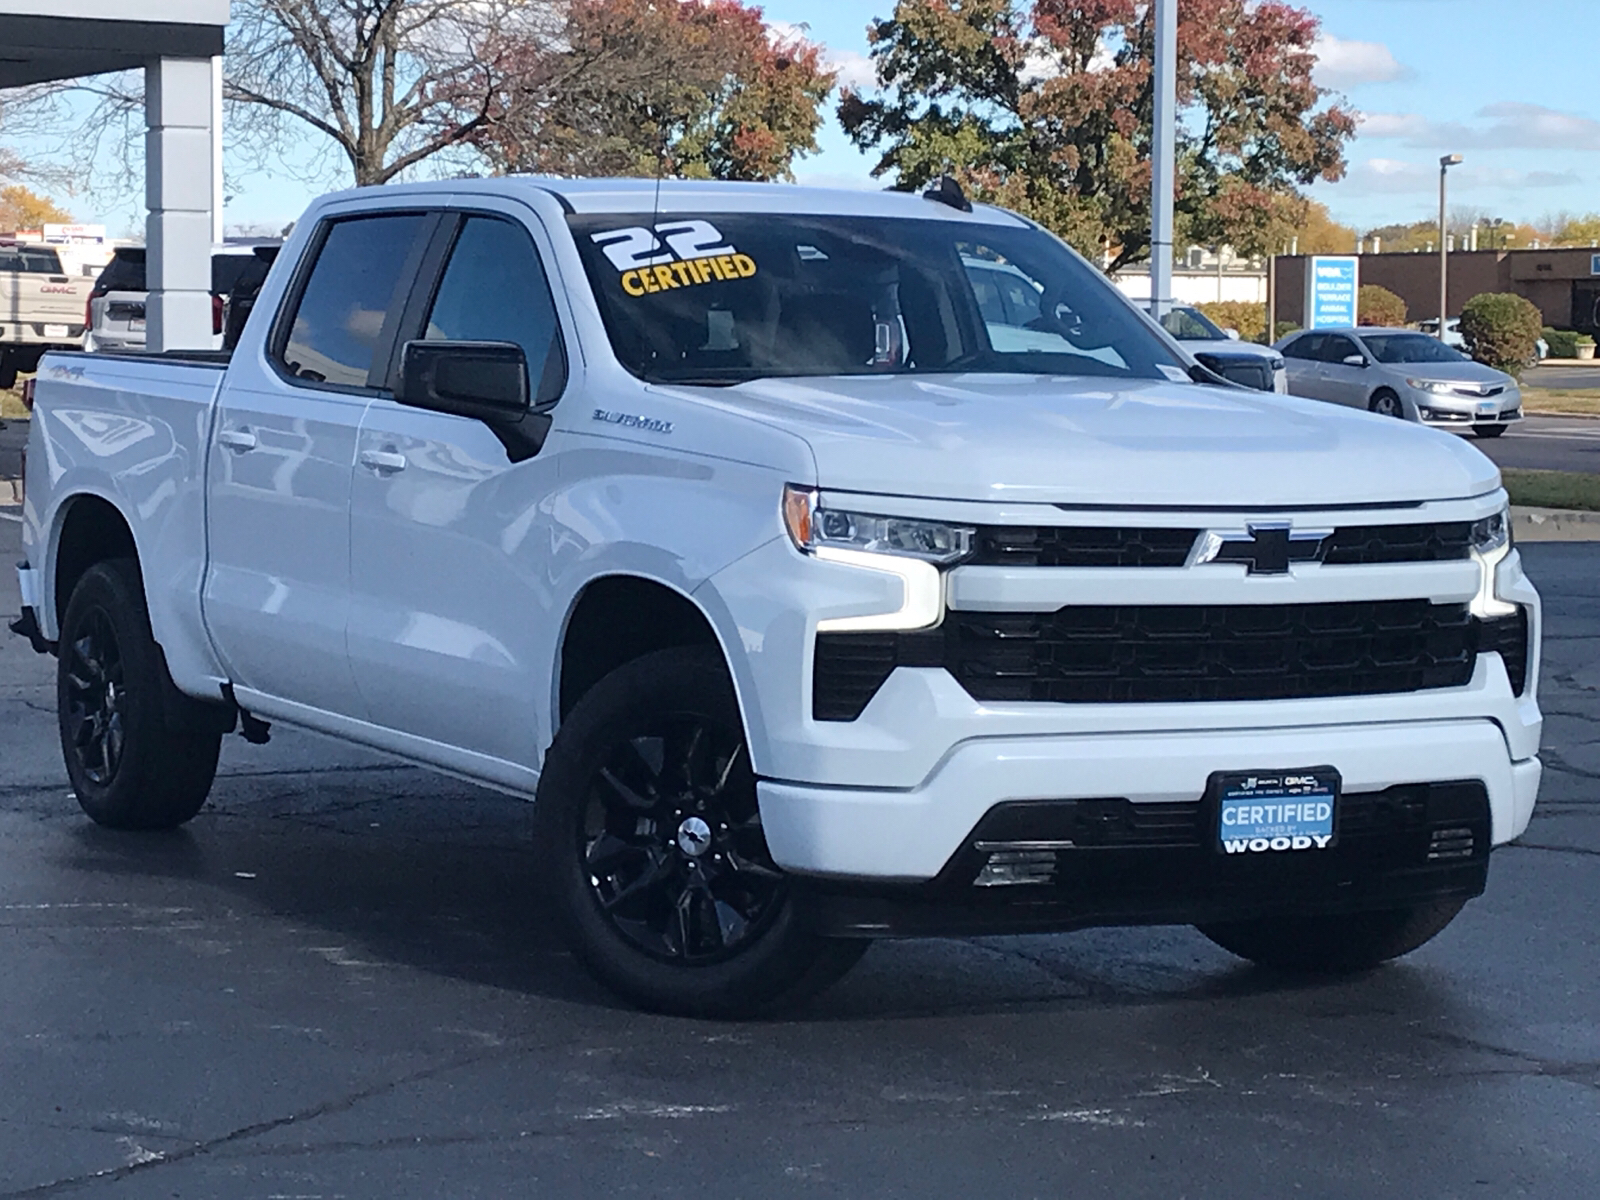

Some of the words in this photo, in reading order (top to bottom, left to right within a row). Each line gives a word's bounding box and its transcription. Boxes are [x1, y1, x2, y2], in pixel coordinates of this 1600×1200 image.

[590, 219, 737, 272] 22
[621, 253, 757, 297] CERTIFIED
[40, 286, 77, 295] GMC
[1222, 803, 1332, 826] CERTIFIED
[1224, 835, 1333, 853] WOODY
